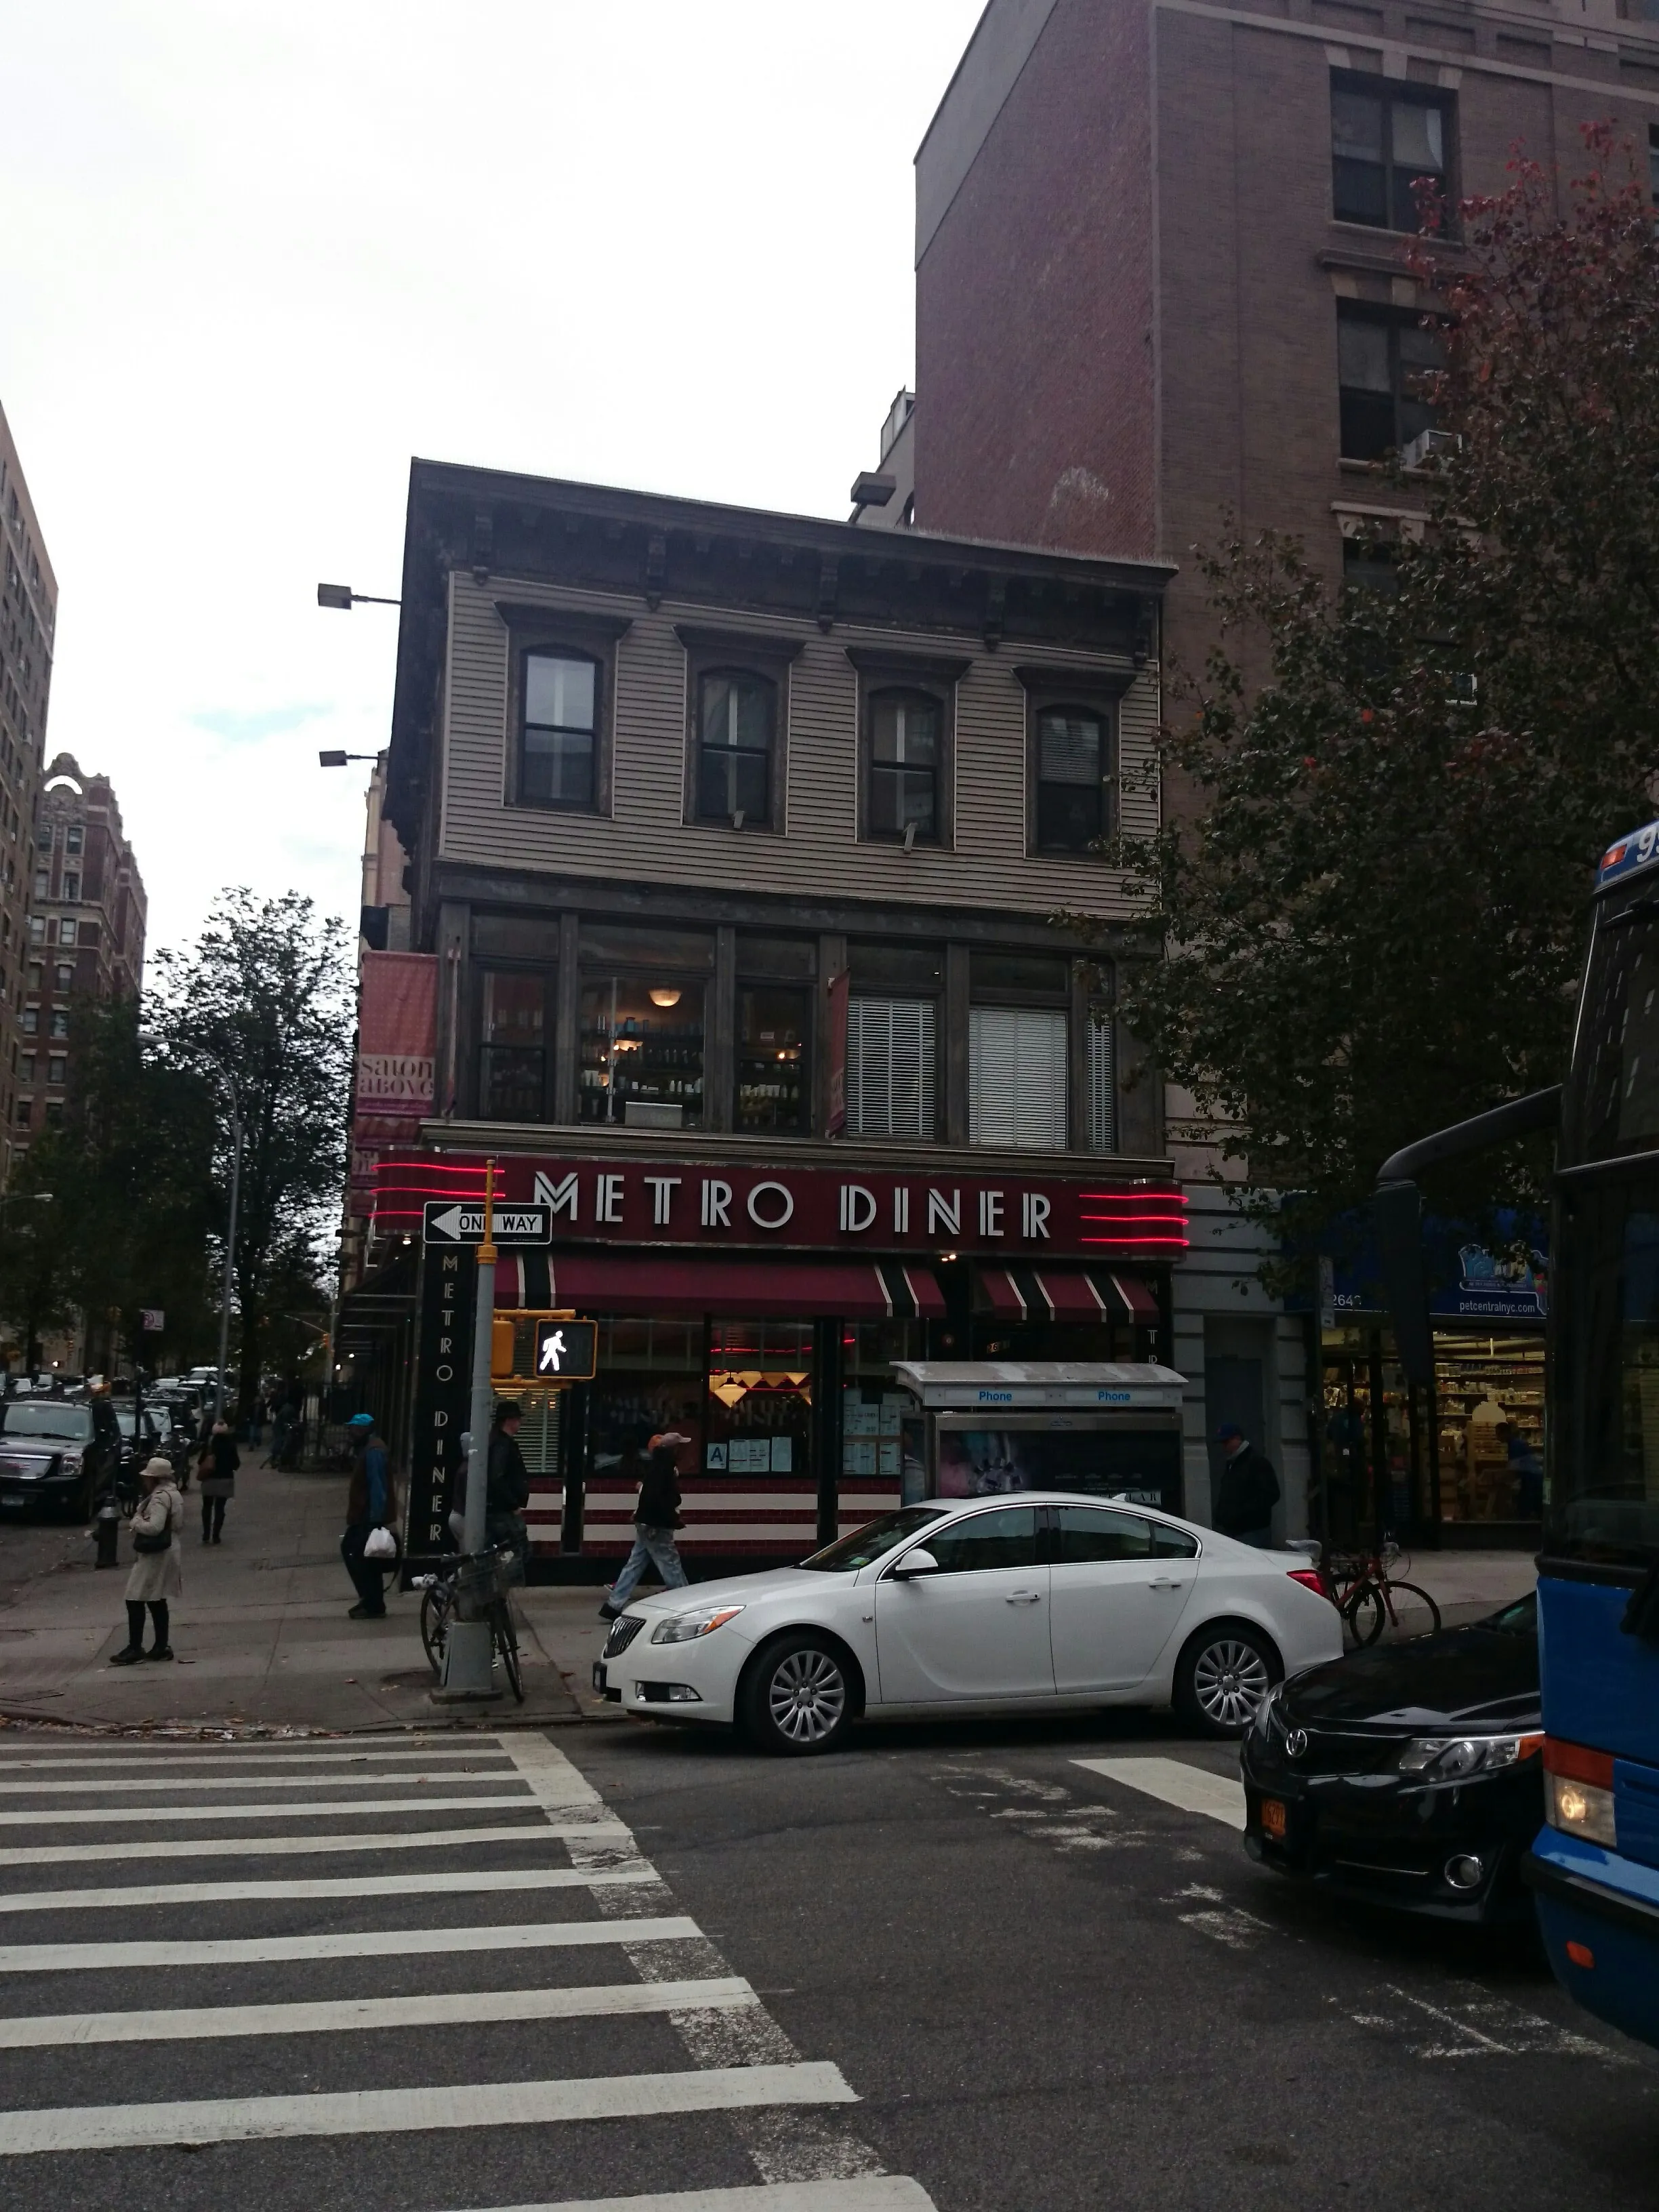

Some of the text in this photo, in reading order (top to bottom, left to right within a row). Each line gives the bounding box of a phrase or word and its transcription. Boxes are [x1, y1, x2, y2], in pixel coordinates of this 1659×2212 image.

[1637, 825, 1659, 864] 9
[534, 1171, 1051, 1239] METRO DINER
[459, 1215, 537, 1231] ON WAY
[1460, 1300, 1535, 1315] petcentralnyc.com
[429, 1255, 459, 1542] METRO DINER
[979, 1391, 1130, 1401] Phone Phone
[710, 1447, 723, 1462] A
